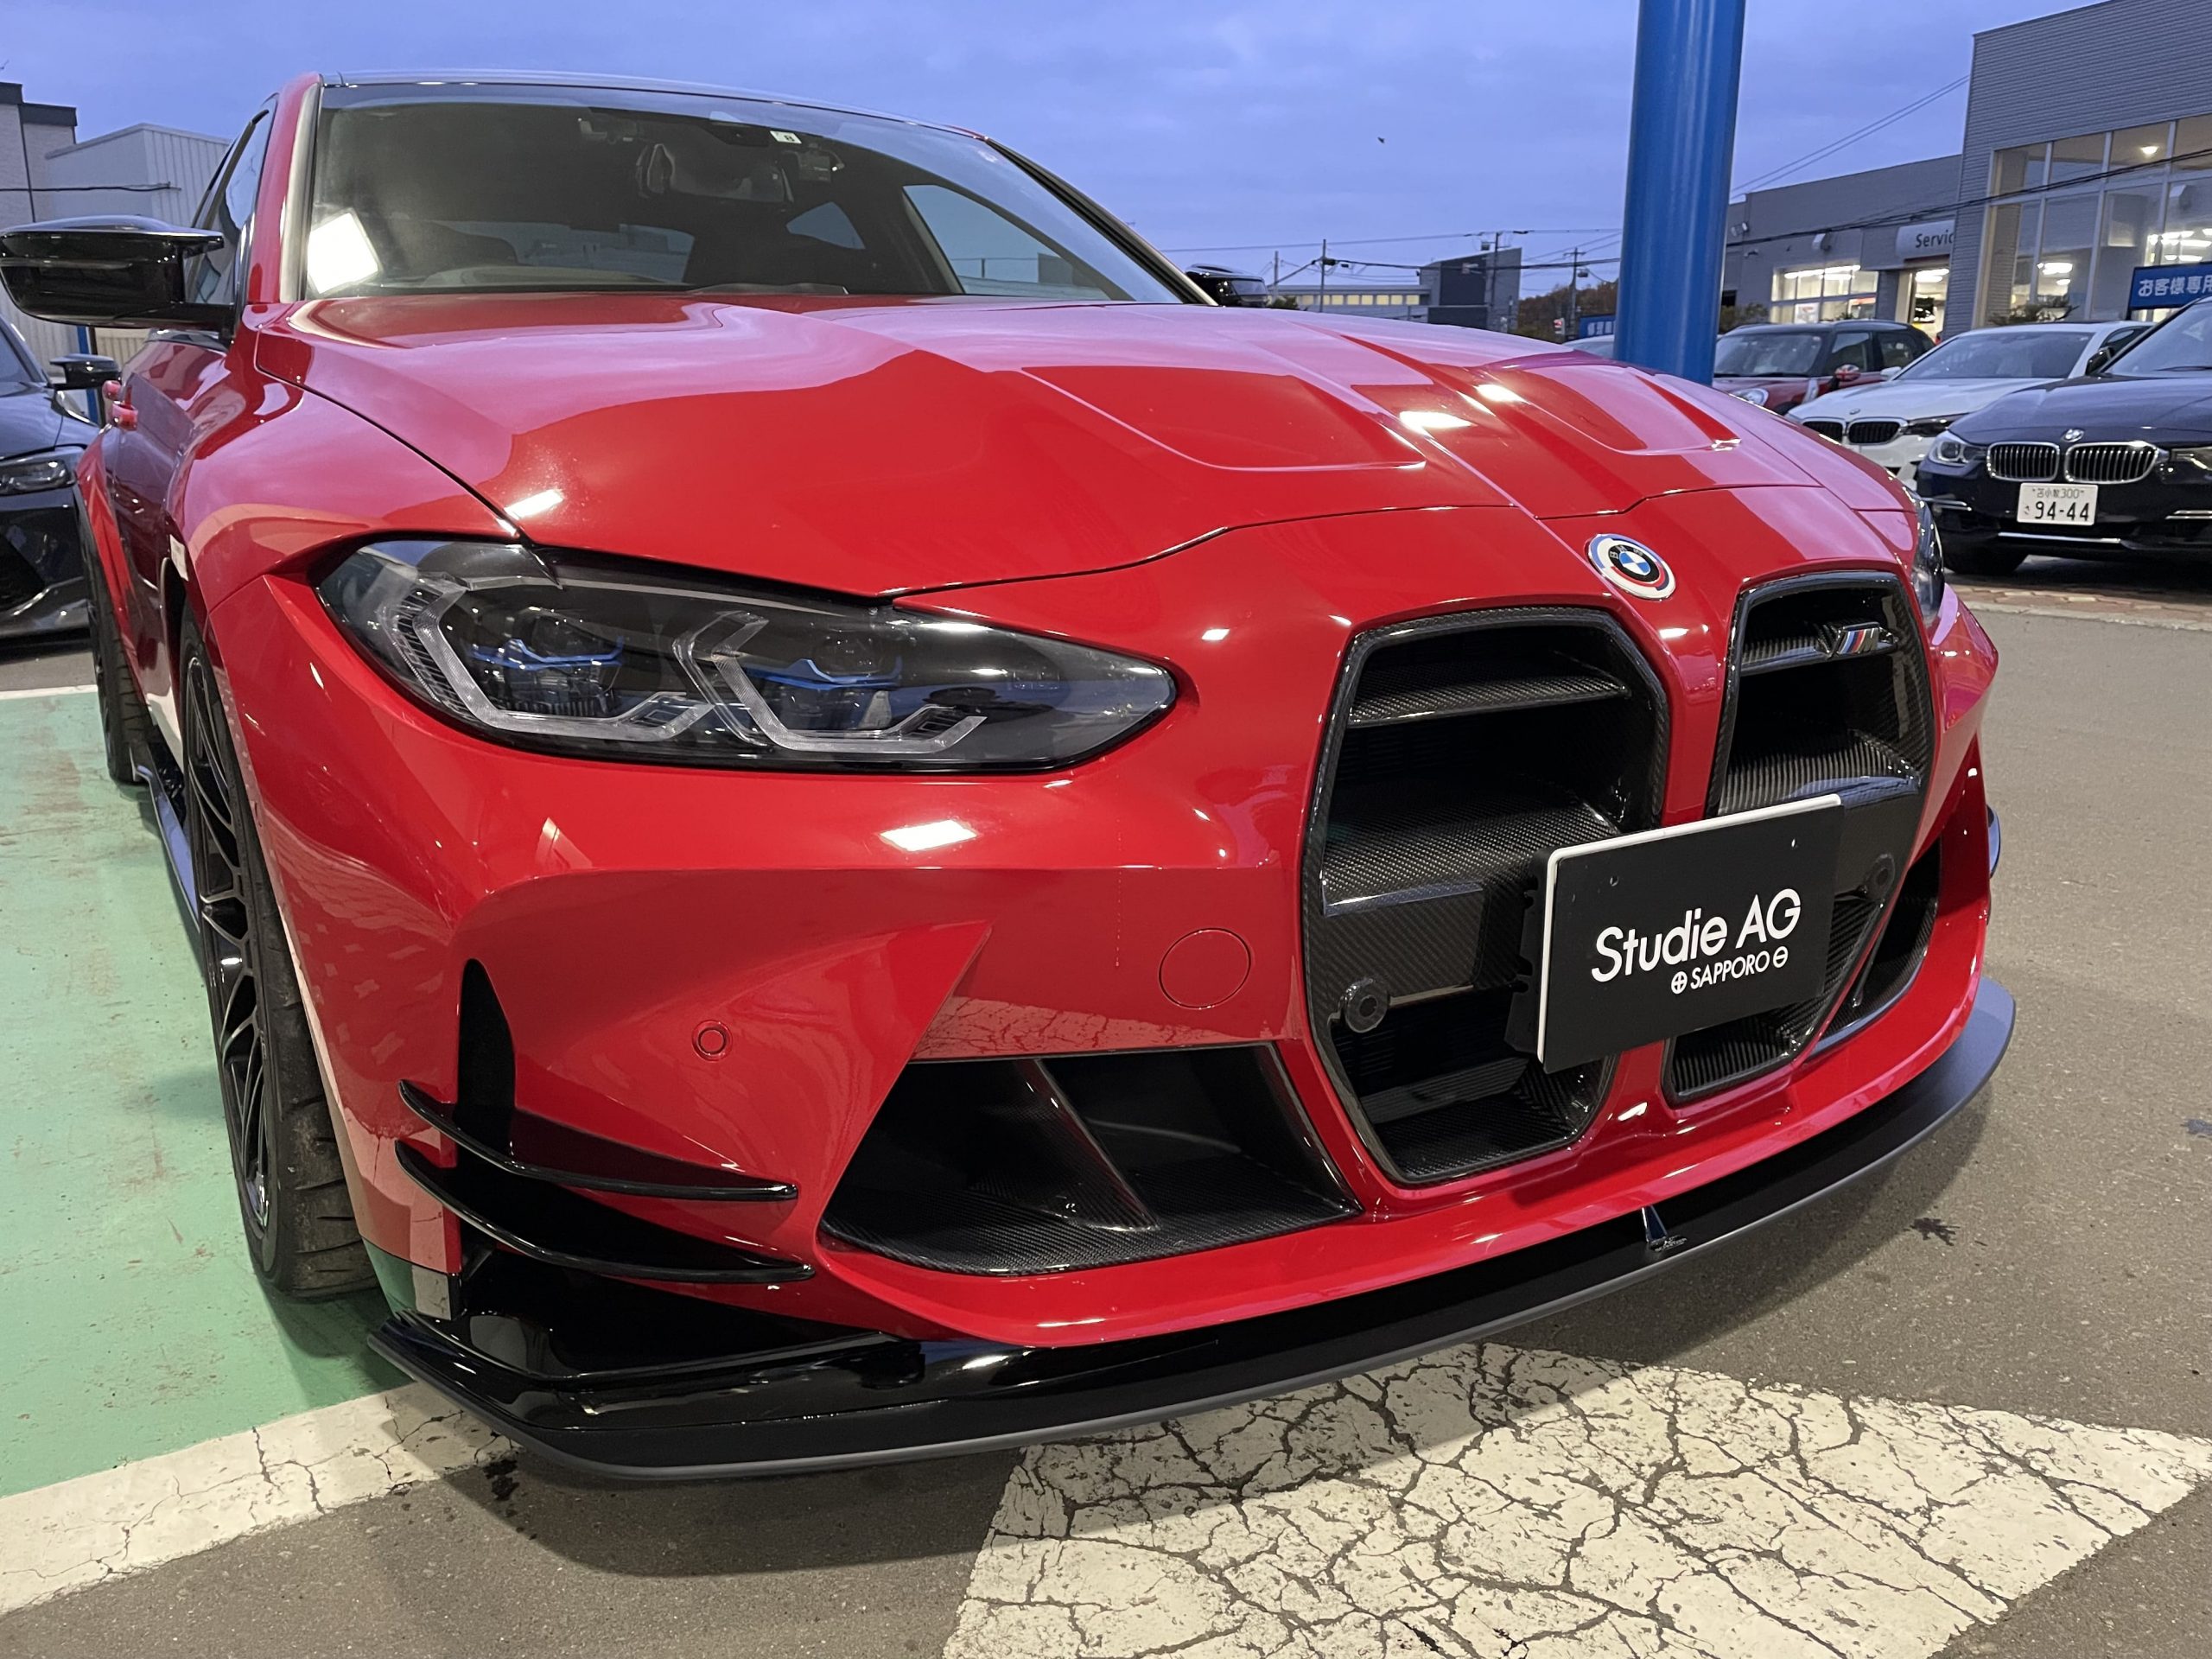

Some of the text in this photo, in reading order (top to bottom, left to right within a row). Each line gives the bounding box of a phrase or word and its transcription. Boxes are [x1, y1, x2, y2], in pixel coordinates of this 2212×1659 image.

[2034, 501, 2089, 521] 94-44
[1592, 888, 1801, 982] Studie AG
[1690, 950, 1770, 989] SAPPORO
